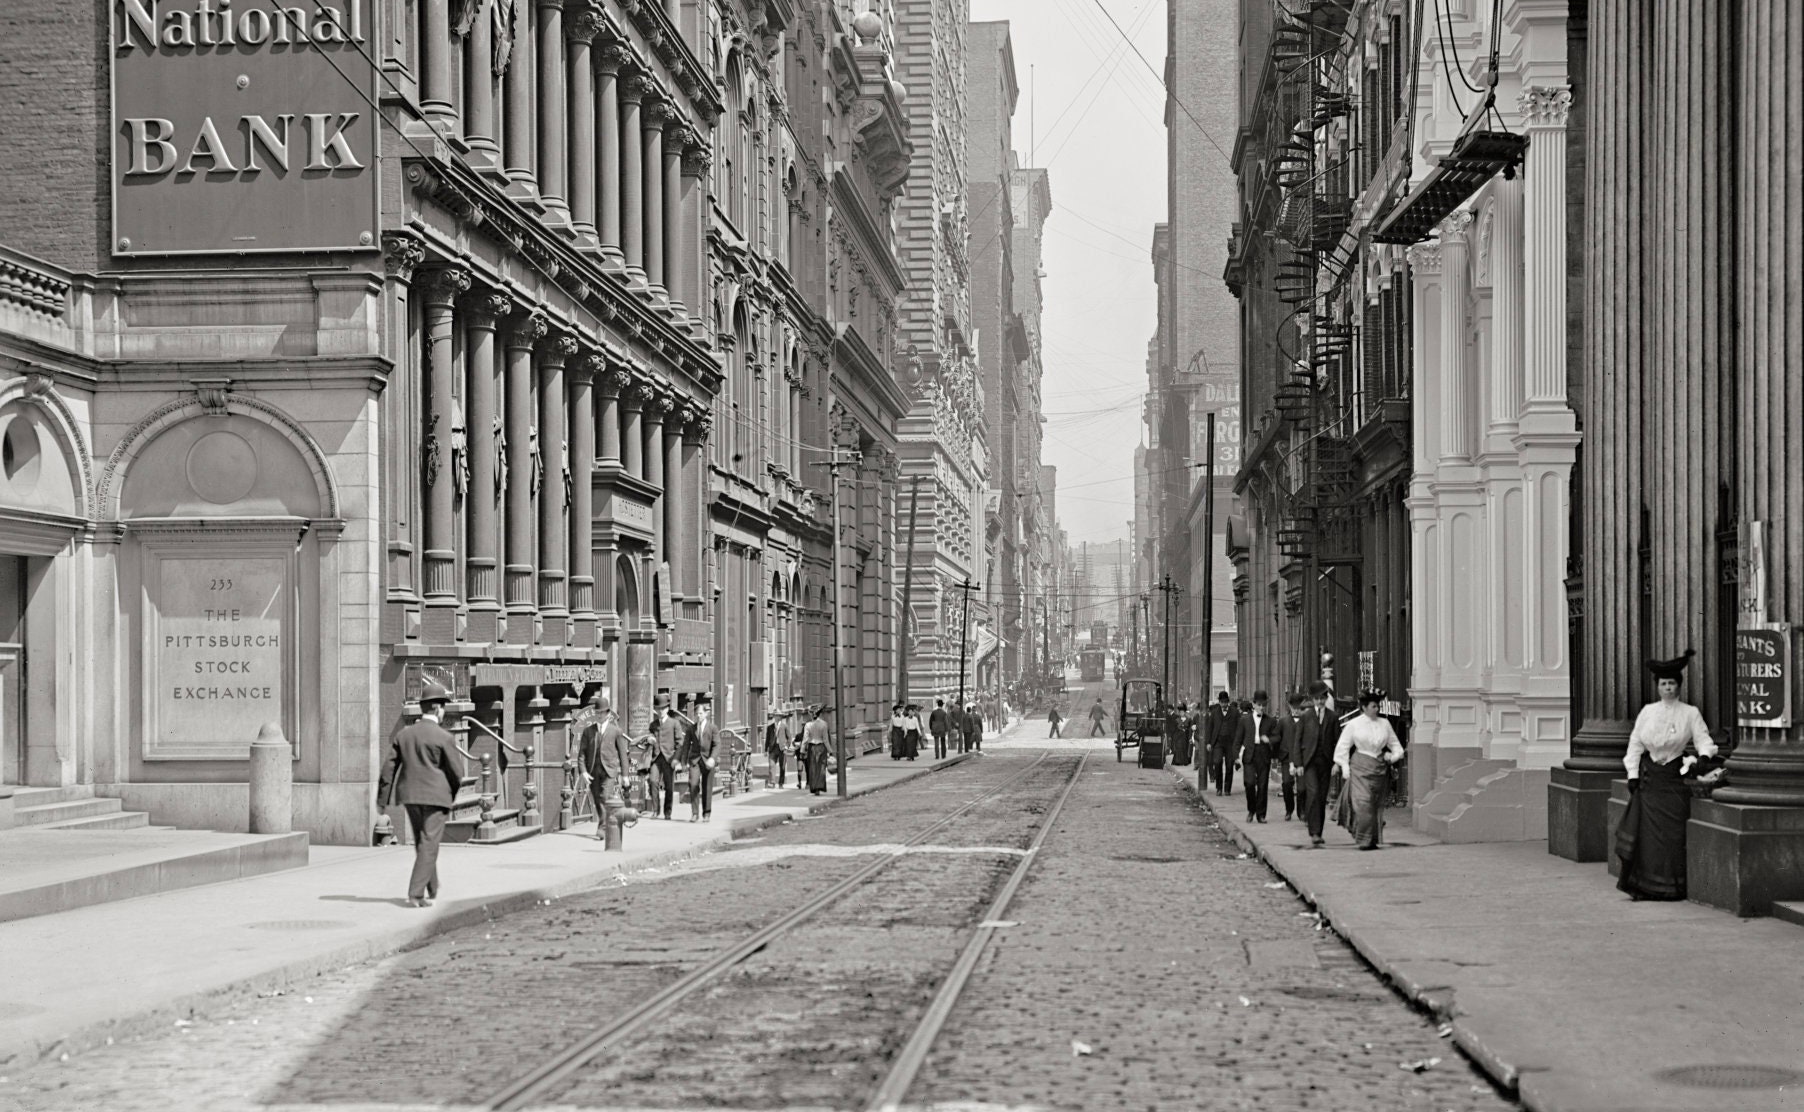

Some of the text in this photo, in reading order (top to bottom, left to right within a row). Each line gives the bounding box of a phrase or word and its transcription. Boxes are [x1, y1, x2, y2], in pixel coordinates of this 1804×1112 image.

[124, 113, 366, 176] BANK
[210, 579, 233, 591] 233
[205, 609, 241, 621] THE
[165, 635, 279, 648] PITTSBURGH
[195, 661, 251, 673] STOCK
[173, 687, 271, 699] EXCHANGE
